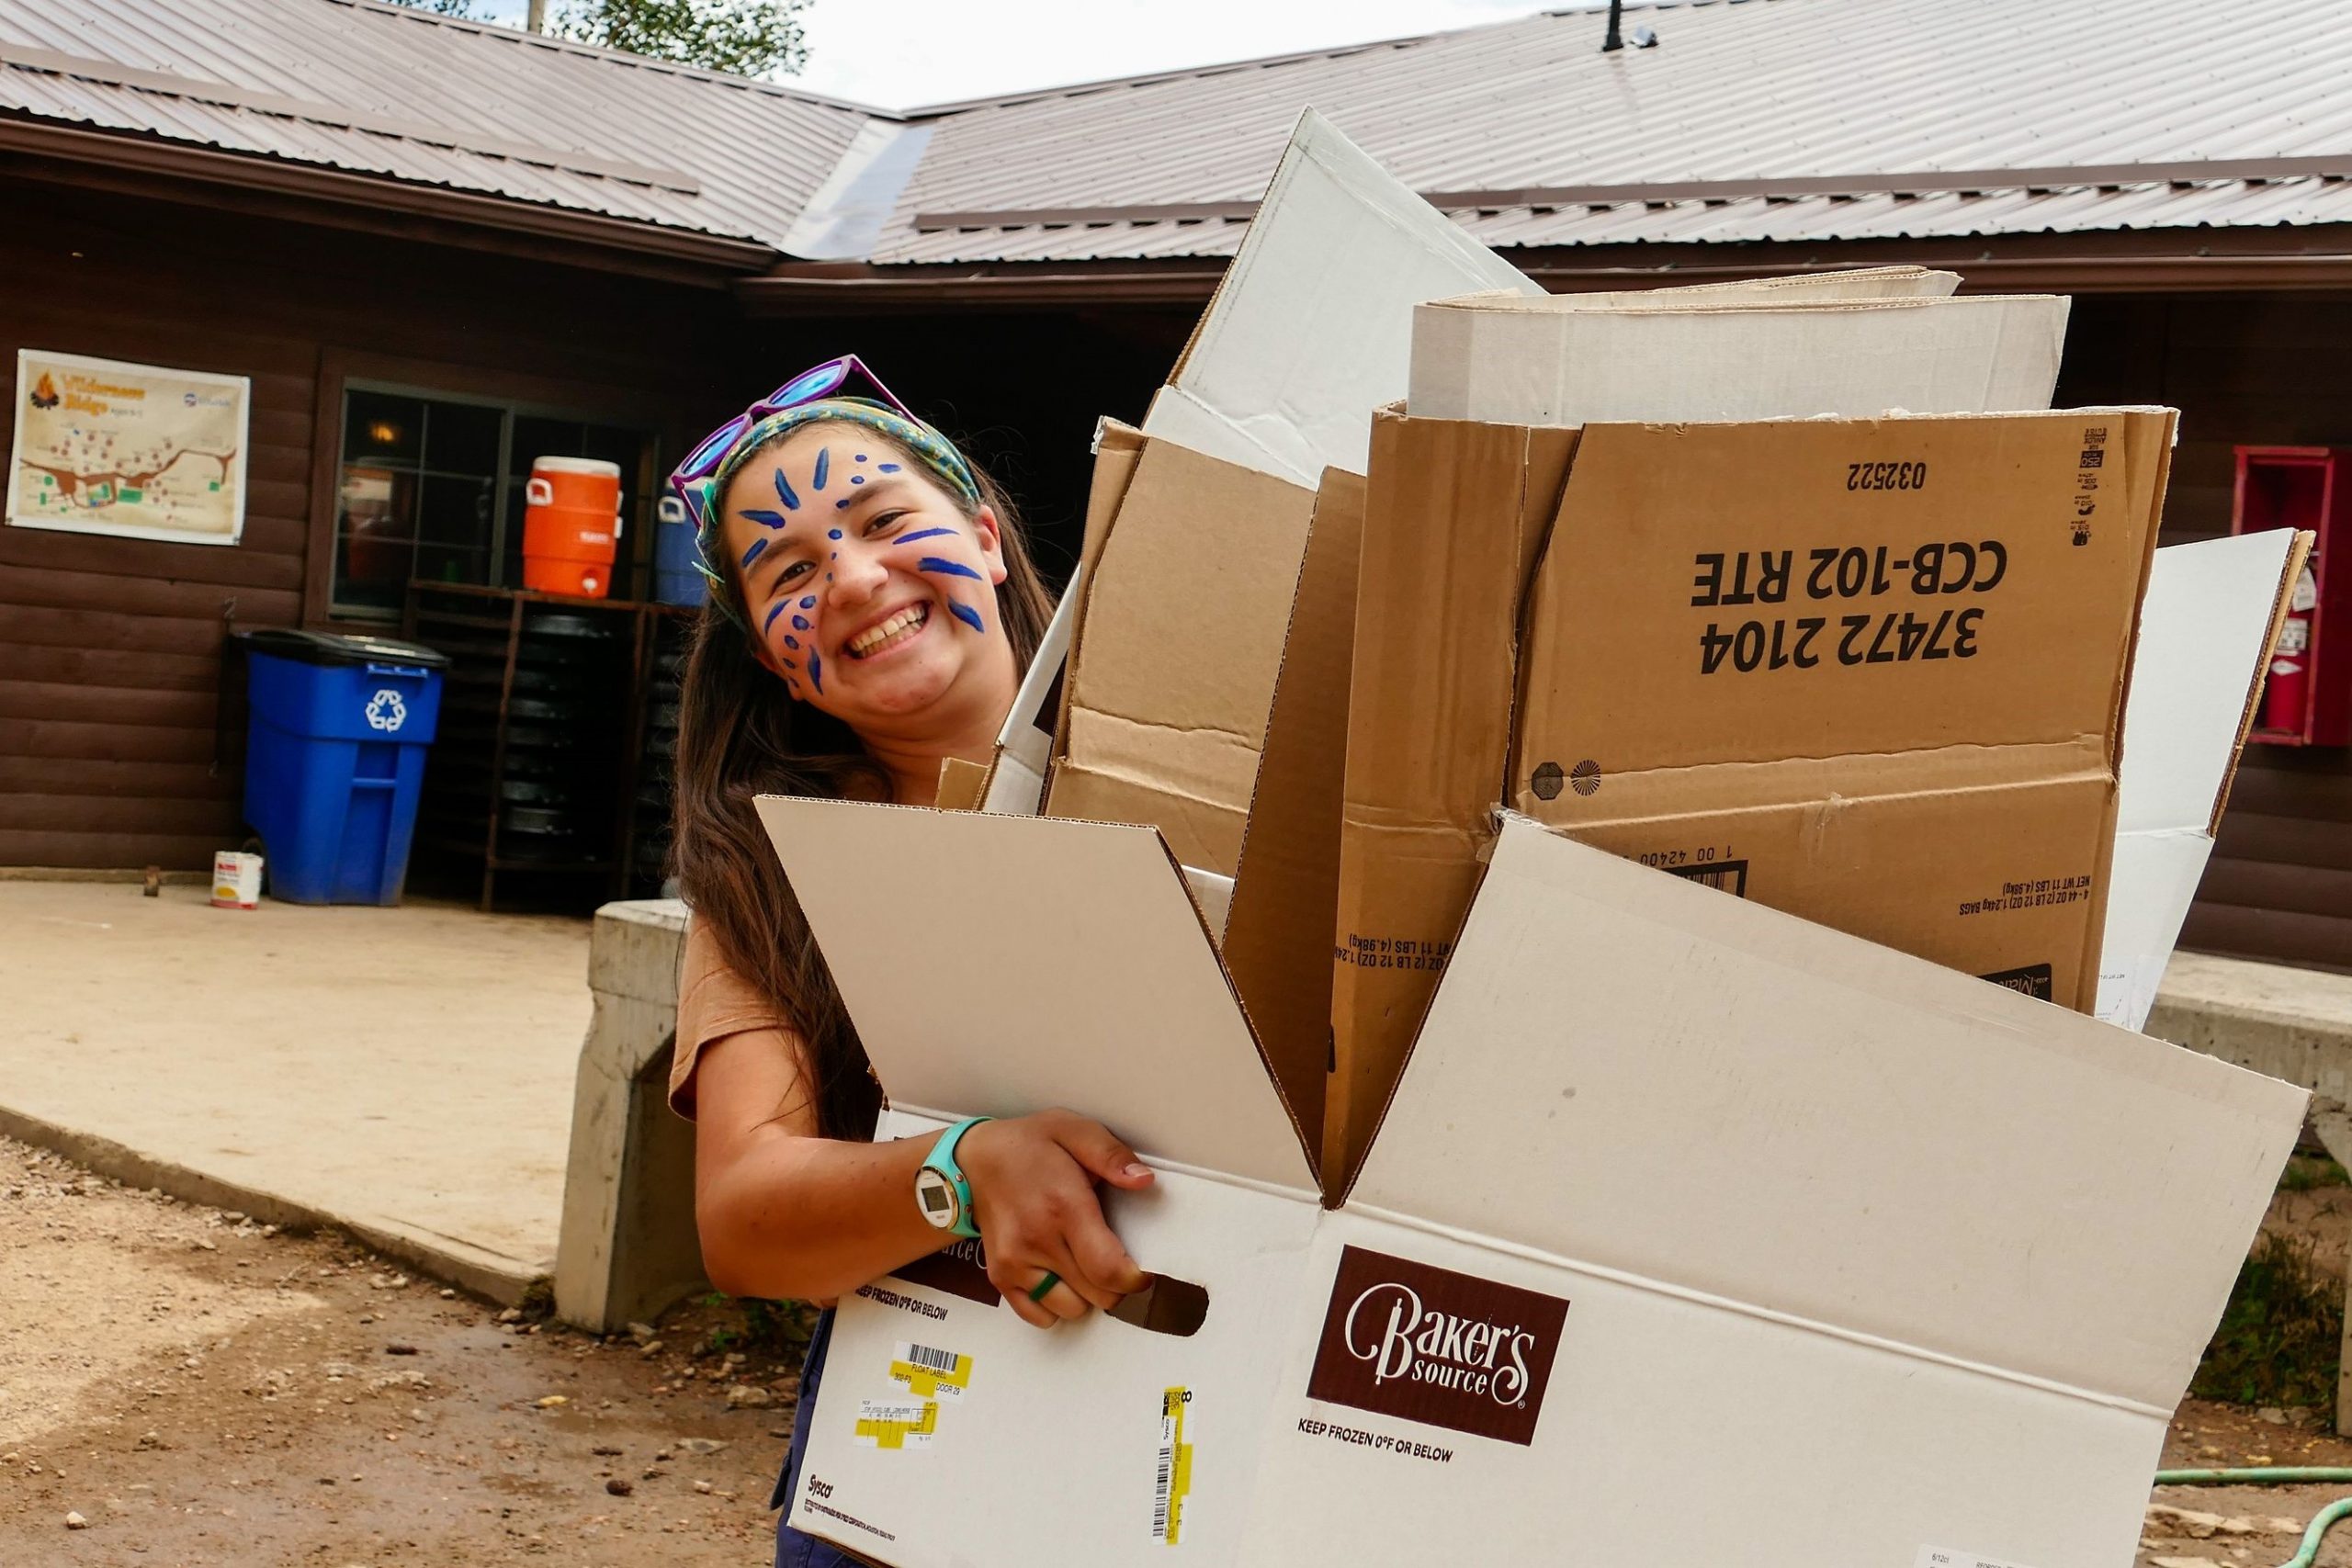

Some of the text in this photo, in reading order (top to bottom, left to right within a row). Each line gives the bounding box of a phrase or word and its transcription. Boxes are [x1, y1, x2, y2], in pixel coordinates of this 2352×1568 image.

[2081, 457, 2100, 466] 250
[1847, 462, 1927, 491] 032522
[1690, 540, 2007, 606] CCB-102 RTE
[1700, 608, 1984, 674] 37472 2104
[1697, 847, 1714, 862] 00
[1726, 845, 1733, 858] 1
[2003, 875, 2090, 897] NET WT 11 LBS (4.98kg)
[2009, 896, 2023, 909] OZ)
[2025, 896, 2034, 908] 12
[2036, 894, 2045, 906] LB
[2047, 891, 2054, 906] (2
[2056, 891, 2066, 904] OZ
[1960, 902, 1981, 915] BAGS
[1983, 898, 2007, 911] 1.24kg
[1349, 933, 1391, 953] (4.98kg)
[1395, 941, 1416, 953] LBS
[1357, 952, 1376, 967] OZ)
[1381, 954, 1394, 967] 12
[1396, 956, 1411, 969] LB
[1415, 955, 1425, 971] (2
[872, 1287, 899, 1307] FROZEN
[911, 1299, 922, 1314] OR
[922, 1303, 948, 1321] BELOW
[911, 1363, 930, 1374] FLOAT
[1411, 1359, 1487, 1395] source
[936, 1382, 953, 1393] DOOR
[1181, 1391, 1192, 1404] 8
[1297, 1418, 1327, 1436] KEEP
[1329, 1425, 1374, 1447] FROZEN
[1395, 1439, 1412, 1455] OR
[1413, 1443, 1453, 1463] BELOW
[808, 1474, 832, 1498] Sysco
